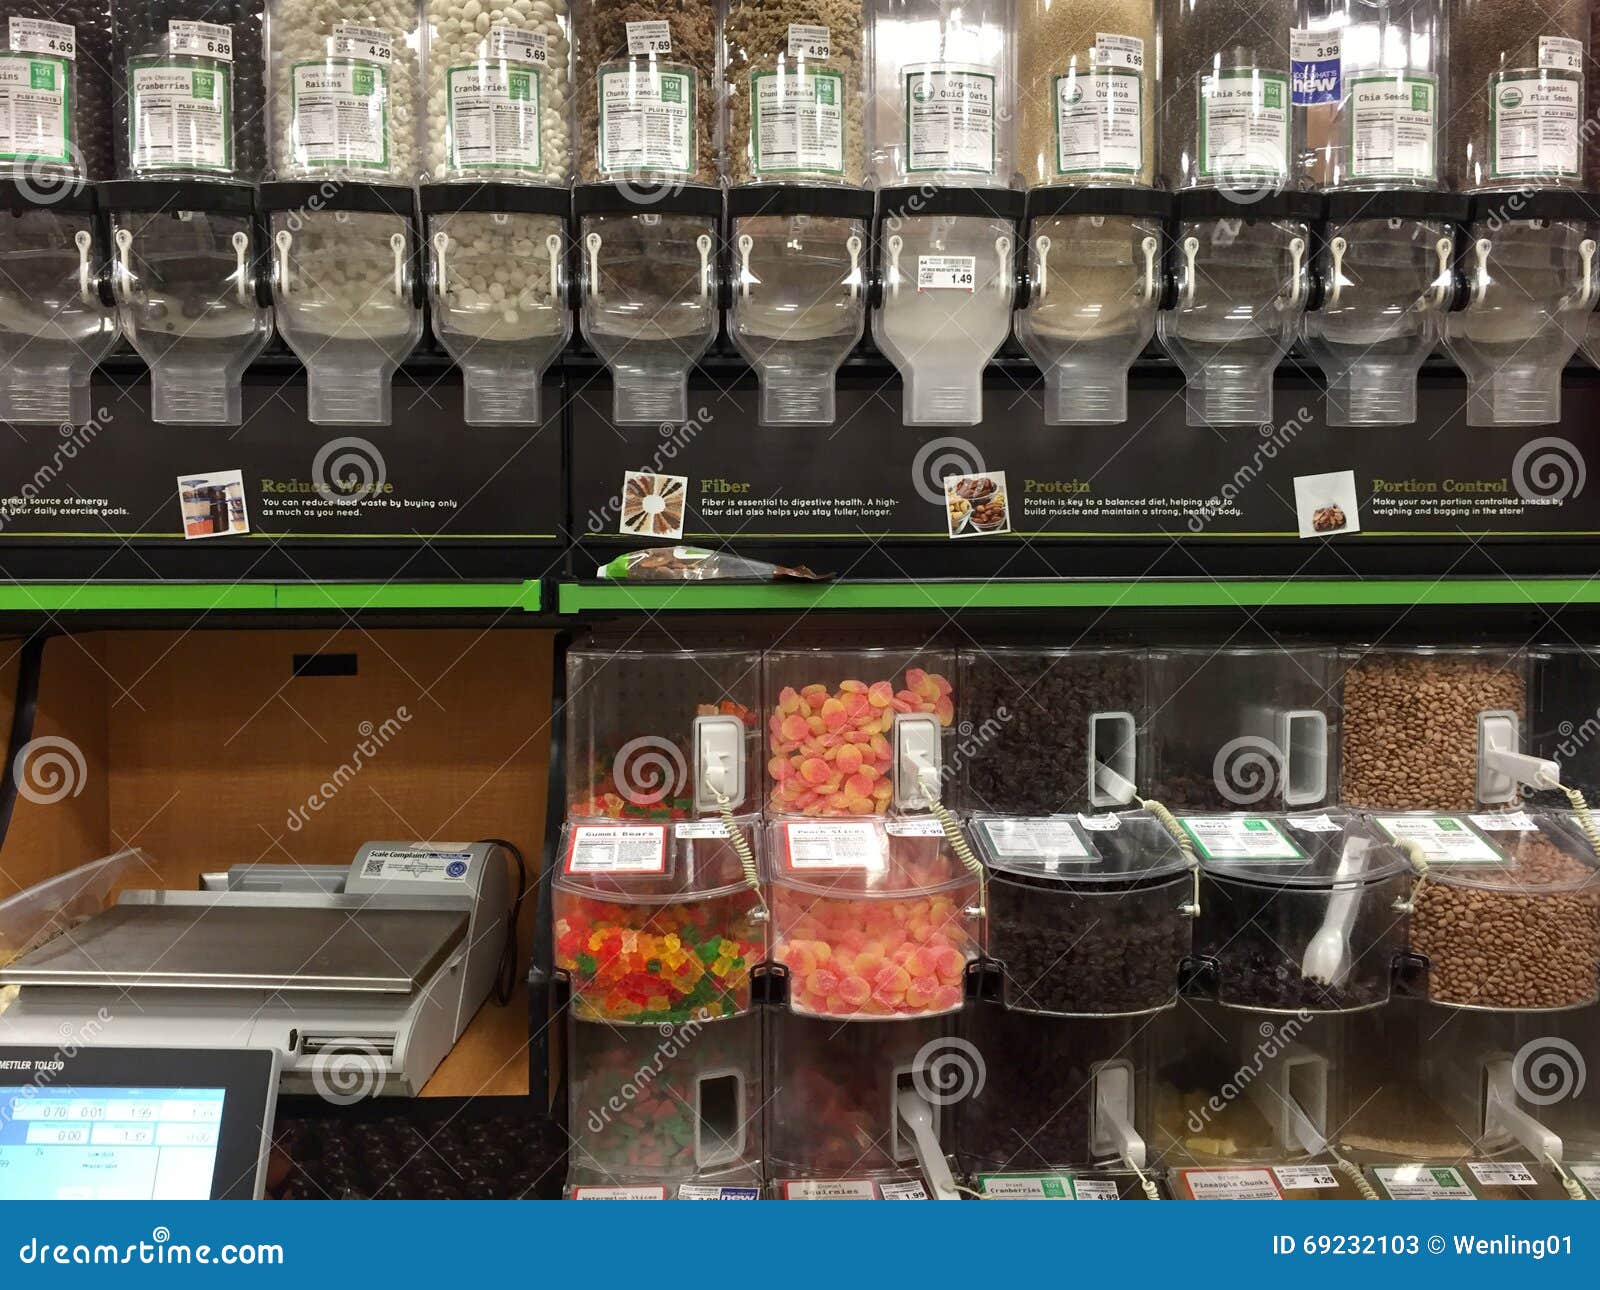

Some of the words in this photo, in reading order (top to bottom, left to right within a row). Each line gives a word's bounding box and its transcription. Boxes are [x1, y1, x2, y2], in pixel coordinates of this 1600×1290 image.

[48, 39, 73, 53] 4.69
[207, 41, 231, 55] 6.89
[649, 40, 670, 51] 7.69
[369, 45, 391, 59] 4.29
[525, 48, 546, 61] 5.69
[809, 46, 829, 56] 4.89
[1317, 45, 1339, 58] 3.99
[1126, 53, 1142, 66] 6.99
[34, 68, 50, 77] 101
[196, 77, 211, 86] 101
[356, 75, 371, 83] 101
[467, 75, 492, 83] Yogt
[512, 78, 527, 87] 101
[137, 82, 190, 91] Cranberries
[305, 80, 341, 89] Raisins
[664, 82, 679, 90] 101
[1095, 80, 1128, 89] Organic
[1293, 76, 1337, 93] new
[1537, 84, 1568, 93] Organic
[606, 89, 629, 98] Chunky
[634, 89, 660, 97] ranola
[1095, 90, 1129, 99] Qunoa
[1266, 87, 1279, 95] 101
[969, 92, 988, 101] Oats
[1358, 93, 1381, 102] Chia
[1384, 93, 1410, 101] Seeds
[1530, 93, 1549, 102] Flax
[1553, 93, 1573, 102] Seeds
[951, 273, 972, 284] 1.49
[261, 478, 331, 494] Reduce
[337, 479, 394, 494] Waste
[700, 478, 752, 494] Fiber
[1024, 478, 1092, 494] Protein
[1372, 478, 1438, 494] Portion
[1442, 478, 1509, 494] Control
[1, 498, 27, 507] great
[63, 497, 73, 506] of
[75, 499, 108, 507] energy
[262, 498, 280, 507] You
[282, 499, 299, 507] can
[302, 498, 334, 508] reduce
[336, 499, 358, 508] food
[360, 499, 388, 508] waste
[390, 499, 402, 510] by
[404, 499, 435, 510] buying
[438, 499, 458, 510] only
[701, 498, 726, 508] Fiber
[728, 498, 736, 508] is
[738, 498, 778, 508] essential
[780, 499, 789, 508] to
[791, 498, 833, 509] digestive
[834, 498, 866, 508] health.
[867, 499, 874, 508] A
[876, 498, 900, 509] high-
[1024, 498, 1056, 507] Protein
[1058, 498, 1066, 507] is
[1067, 498, 1084, 508] key
[1086, 499, 1095, 507] to
[1105, 498, 1146, 507] balanced
[1148, 498, 1169, 508] diet,
[1170, 498, 1203, 508] helping
[1205, 499, 1222, 508] you
[1223, 498, 1233, 507] to
[1372, 497, 1397, 507] Make
[1398, 499, 1418, 508] your
[1420, 499, 1438, 507] own
[1440, 497, 1473, 509] portion
[1474, 497, 1519, 507] controlled
[1520, 498, 1550, 508] snacks
[1552, 497, 1564, 508] by
[10, 509, 31, 517] your
[34, 506, 57, 516] daily
[60, 507, 99, 516] exercise
[101, 507, 130, 517] goals.
[262, 509, 274, 517] as
[276, 508, 302, 517] much
[304, 509, 315, 517] as
[317, 509, 334, 519] you
[336, 508, 363, 518] need.
[701, 508, 724, 518] fiber
[726, 508, 744, 518] diet
[746, 508, 765, 518] also
[767, 508, 792, 519] helps
[793, 510, 810, 519] you
[812, 508, 832, 519] stay
[834, 508, 860, 518] fuller,
[861, 508, 893, 518] longer.
[1024, 507, 1046, 516] build
[1049, 507, 1080, 516] muscle
[1082, 507, 1099, 516] and
[1101, 507, 1140, 516] maintain
[1150, 508, 1182, 518] strong,
[1183, 507, 1216, 518] healthy
[1218, 507, 1244, 518] body.
[1373, 507, 1413, 517] weighing
[1414, 507, 1432, 516] and
[1433, 507, 1470, 517] bagging
[1472, 507, 1481, 516] in
[1482, 507, 1498, 516] the
[1499, 507, 1525, 516] store!
[622, 830, 655, 838] Bears
[389, 851, 429, 860] Complaint?
[0, 1060, 31, 1070] METTLER
[34, 1060, 65, 1071] TOLEDO
[1313, 1176, 1335, 1185] 4.29
[1509, 1173, 1532, 1182] 2.29
[1193, 1181, 1238, 1190] Pineapple
[1239, 1179, 1269, 1188] Chunks
[803, 1189, 859, 1197] Suirmies
[905, 1191, 925, 1200] 1.99
